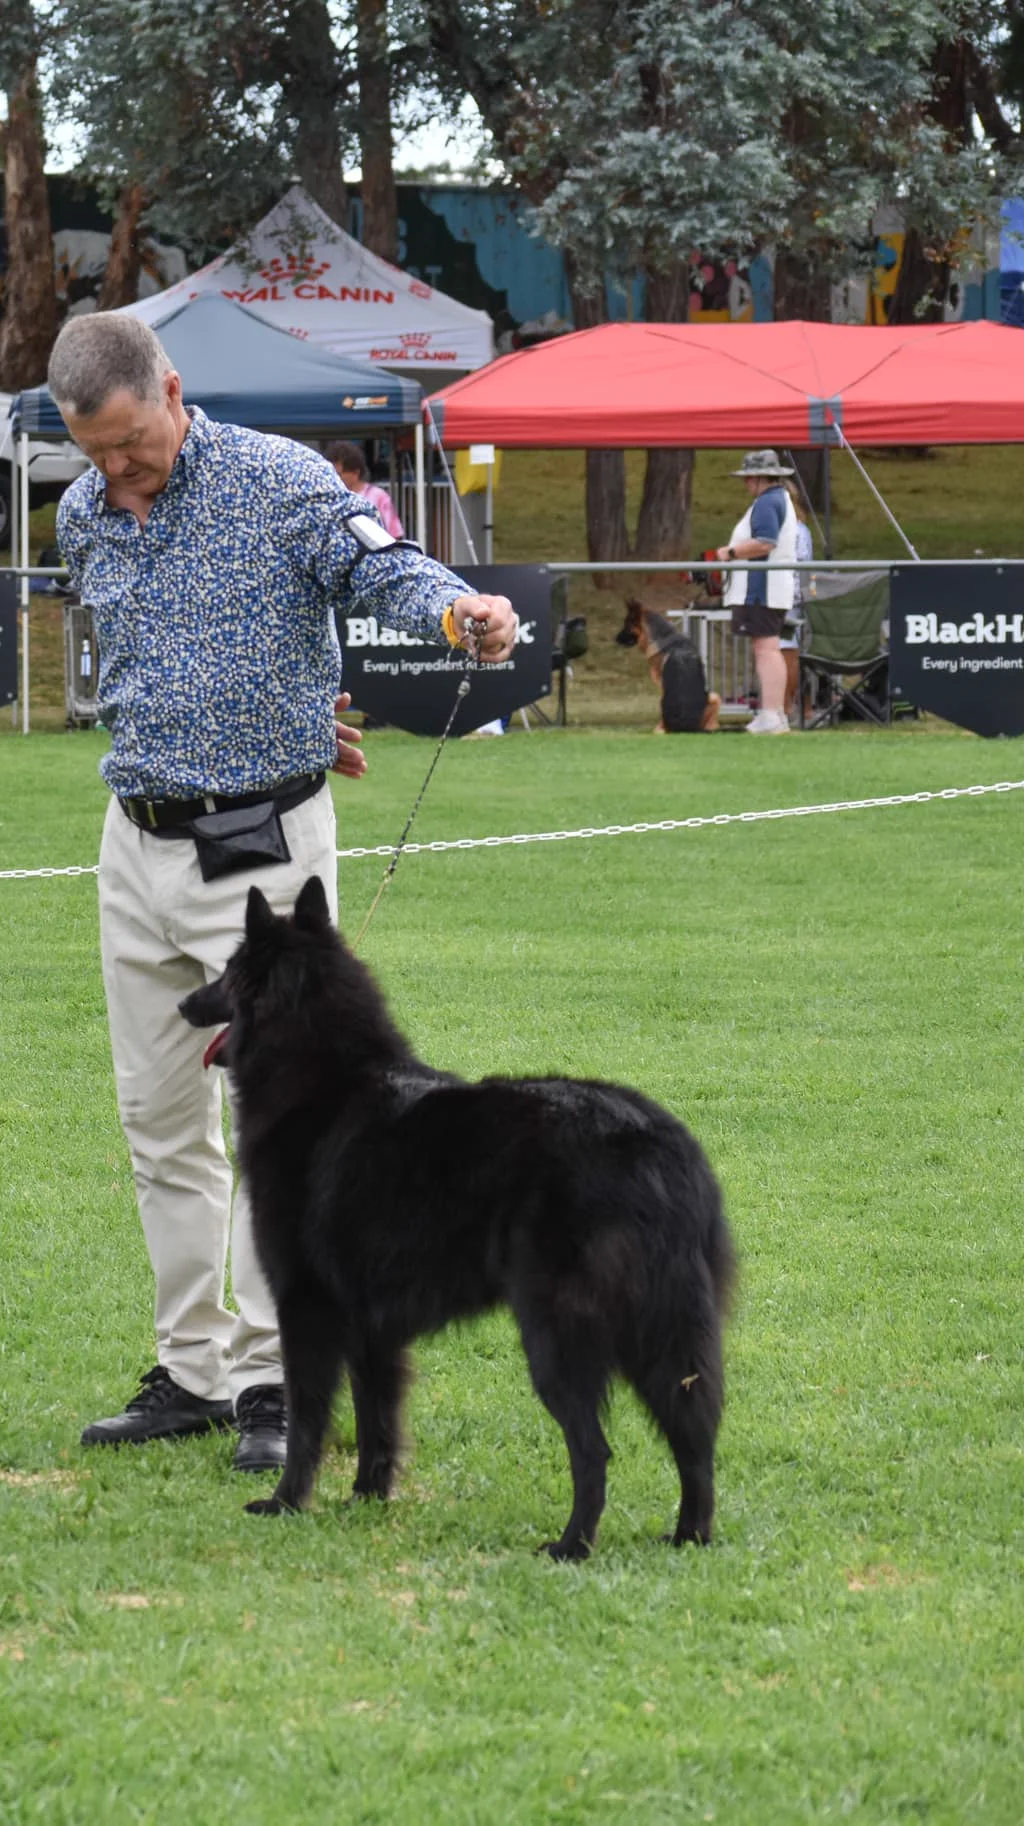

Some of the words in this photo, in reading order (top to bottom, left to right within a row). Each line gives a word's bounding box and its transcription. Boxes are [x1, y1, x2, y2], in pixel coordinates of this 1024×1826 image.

[220, 285, 286, 303] YAL
[293, 283, 395, 305] CANIN
[369, 347, 409, 360] ROYAL
[413, 349, 457, 361] CANIN
[904, 612, 1024, 644] BlackH
[362, 659, 400, 676] Every
[401, 658, 465, 676] ingredient
[922, 656, 958, 673] Every
[959, 656, 1024, 673] ingredient
